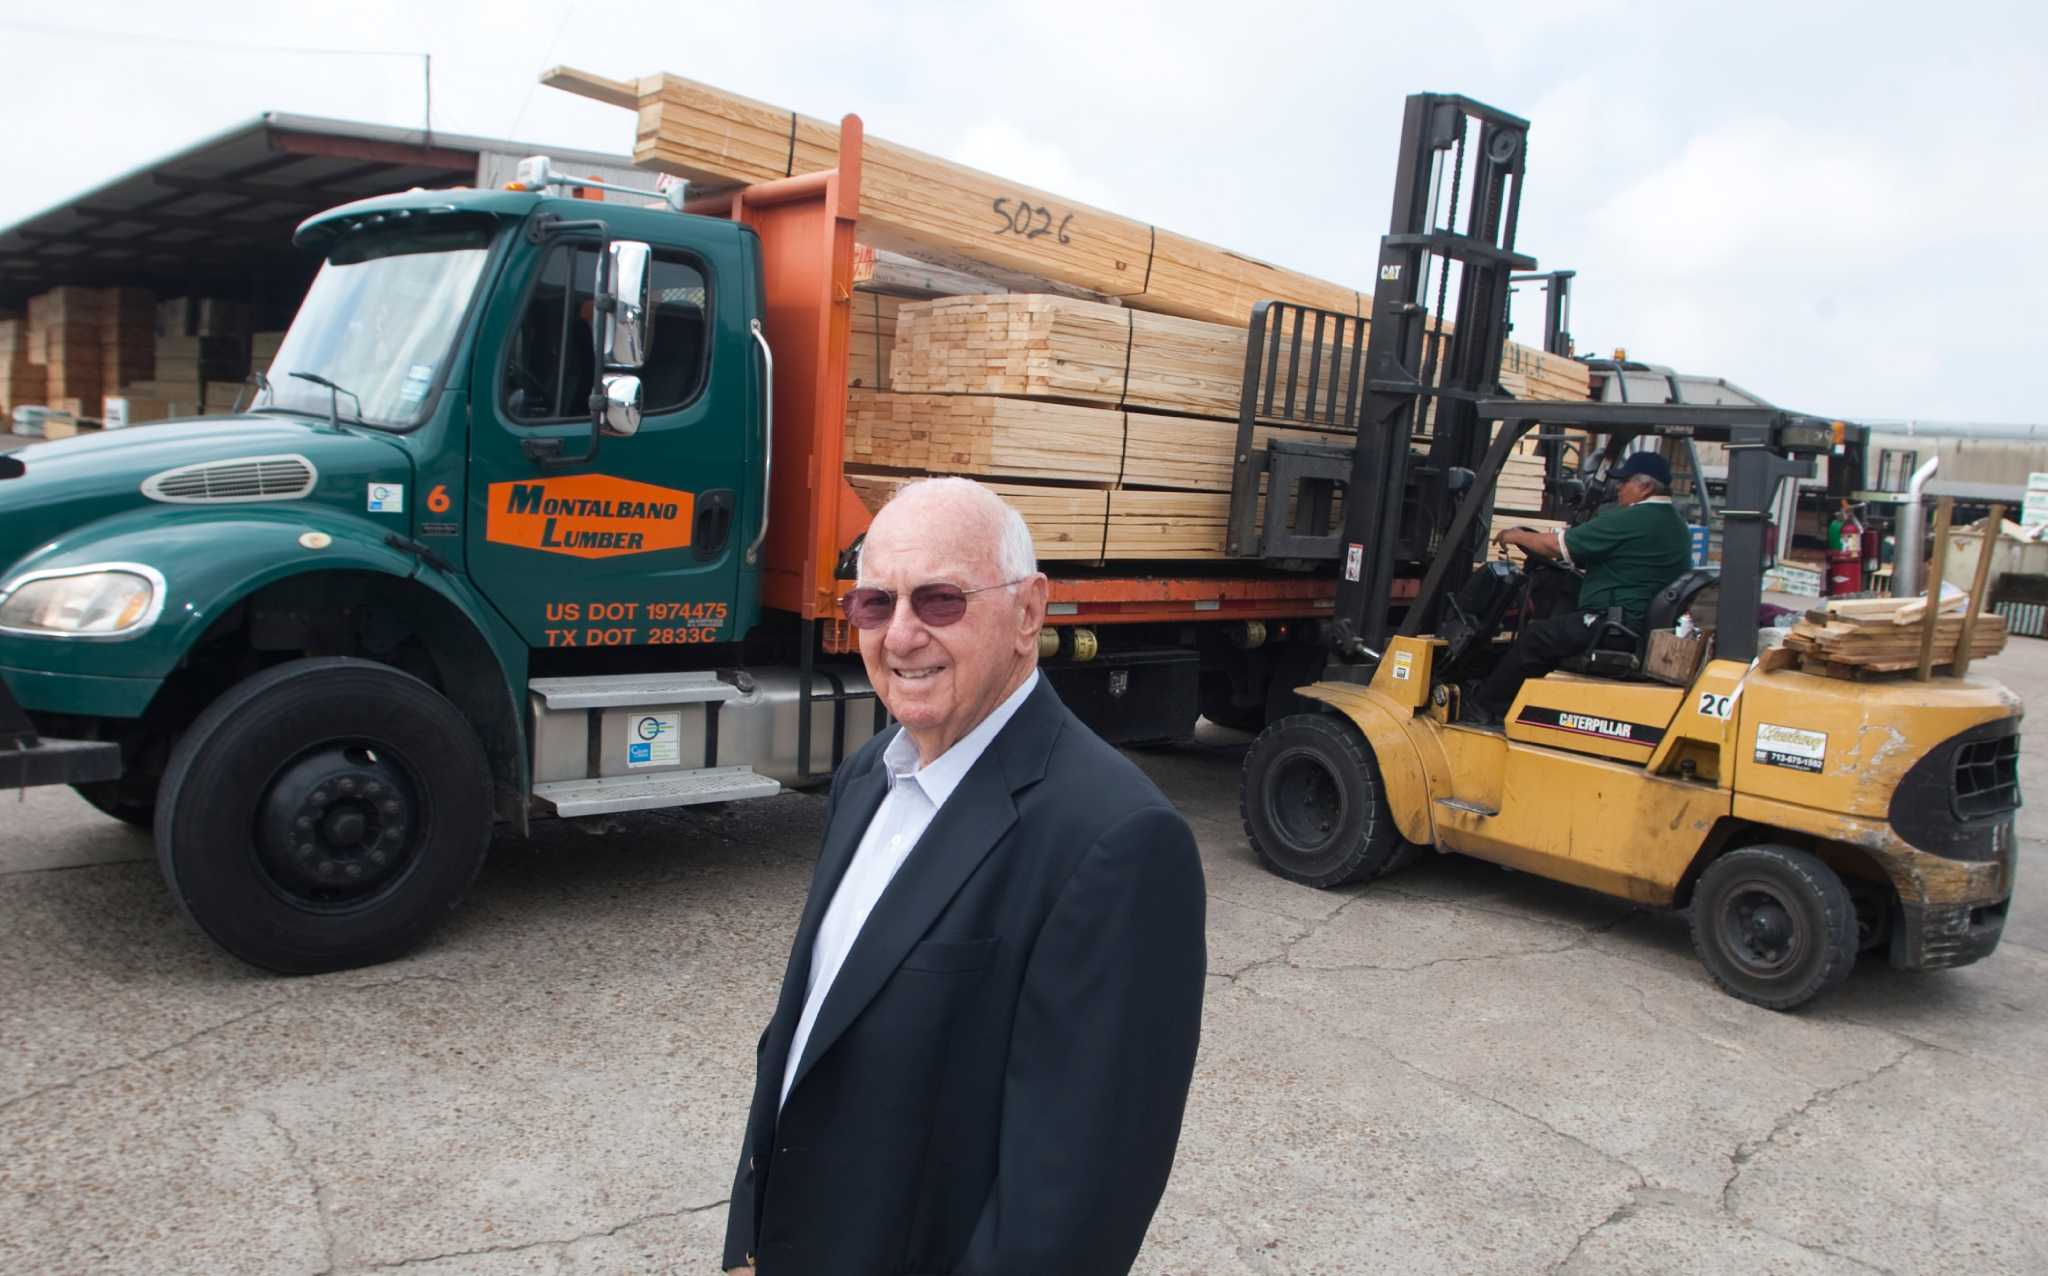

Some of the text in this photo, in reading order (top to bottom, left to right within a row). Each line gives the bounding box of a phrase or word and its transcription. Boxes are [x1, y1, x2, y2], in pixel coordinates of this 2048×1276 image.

[1381, 264, 1402, 280] CAT
[427, 484, 449, 513] 6
[507, 484, 677, 520] MONTALBANO
[541, 518, 643, 549] LUMBER
[545, 602, 727, 621] US DOT 1974475
[544, 627, 717, 647] TX DOT 2833C
[1559, 713, 1631, 738] CATERPILLAR
